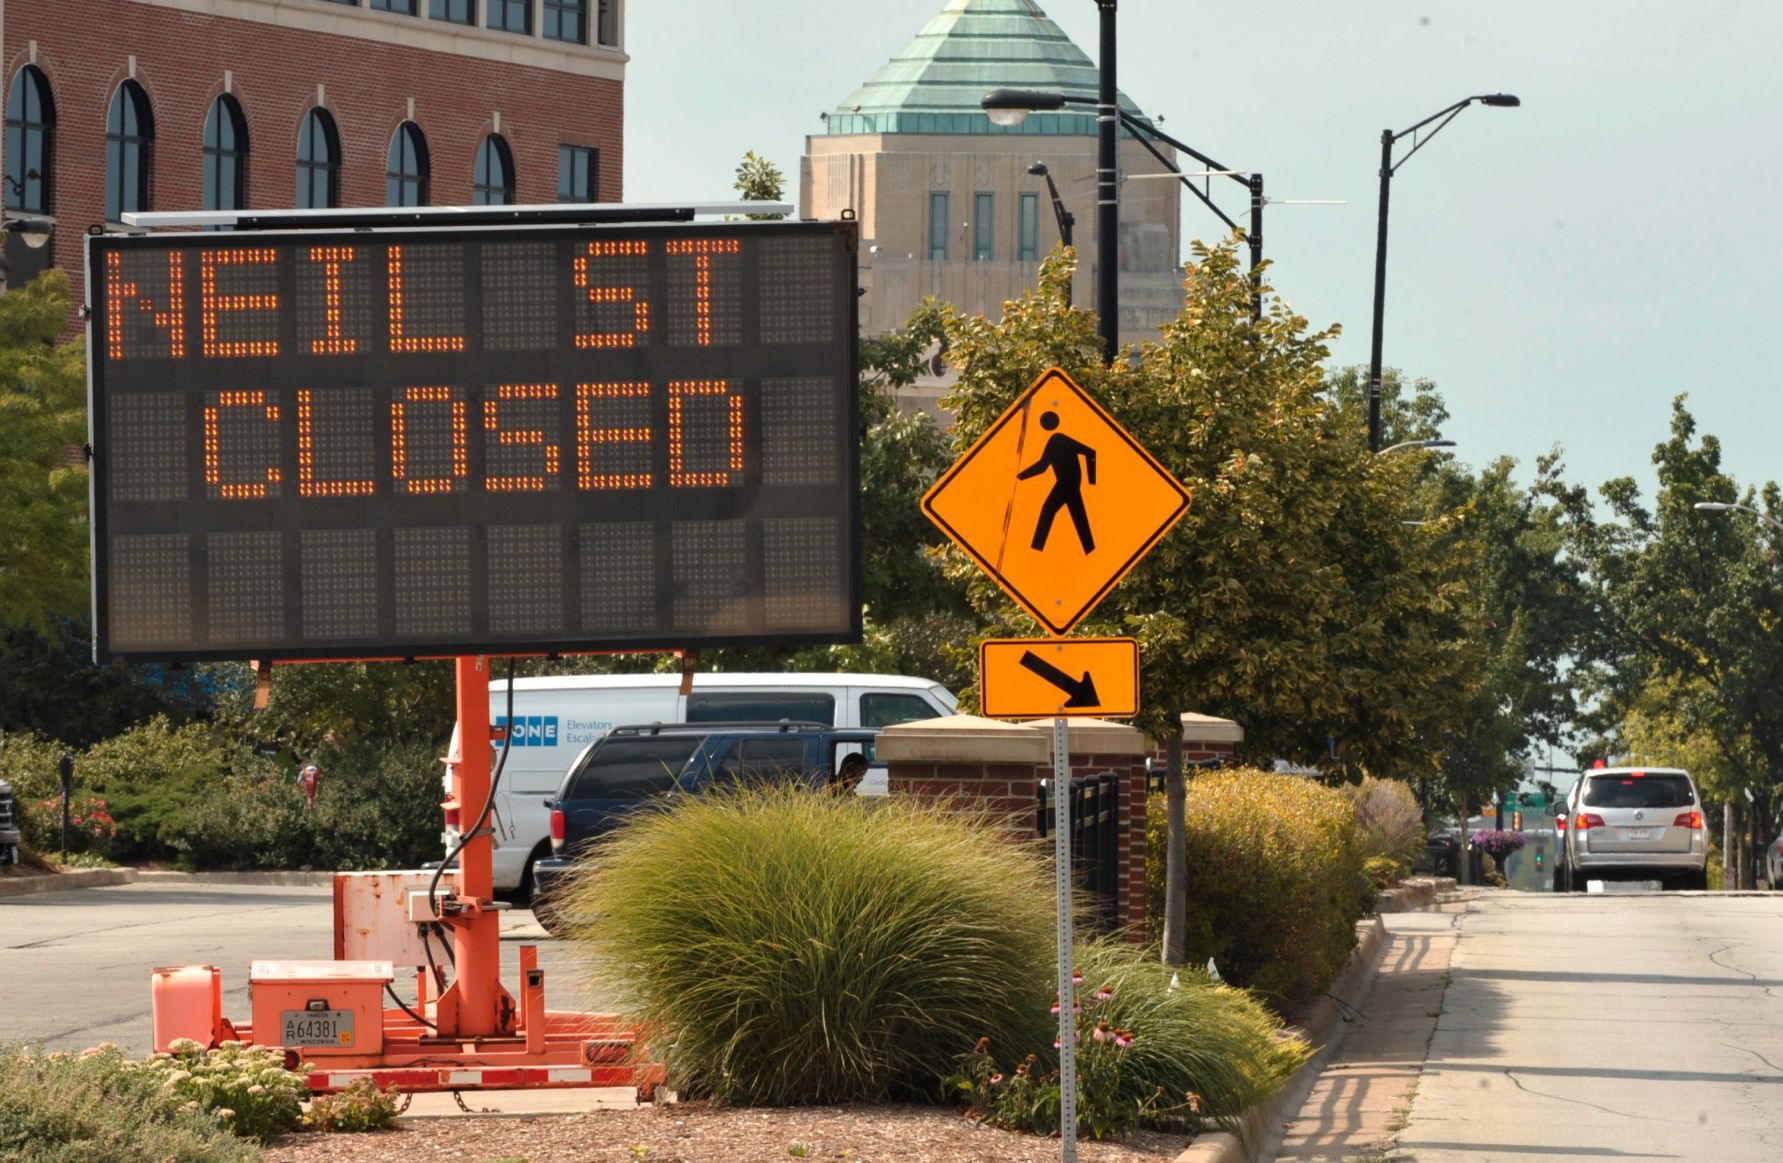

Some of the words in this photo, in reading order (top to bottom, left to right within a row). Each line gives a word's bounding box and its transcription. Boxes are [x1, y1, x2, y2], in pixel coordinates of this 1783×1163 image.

[107, 246, 465, 359] NEIL
[574, 239, 739, 349] ST
[204, 380, 744, 499] CLOSED
[566, 719, 612, 730] Elevators
[297, 1020, 338, 1038] 64381
